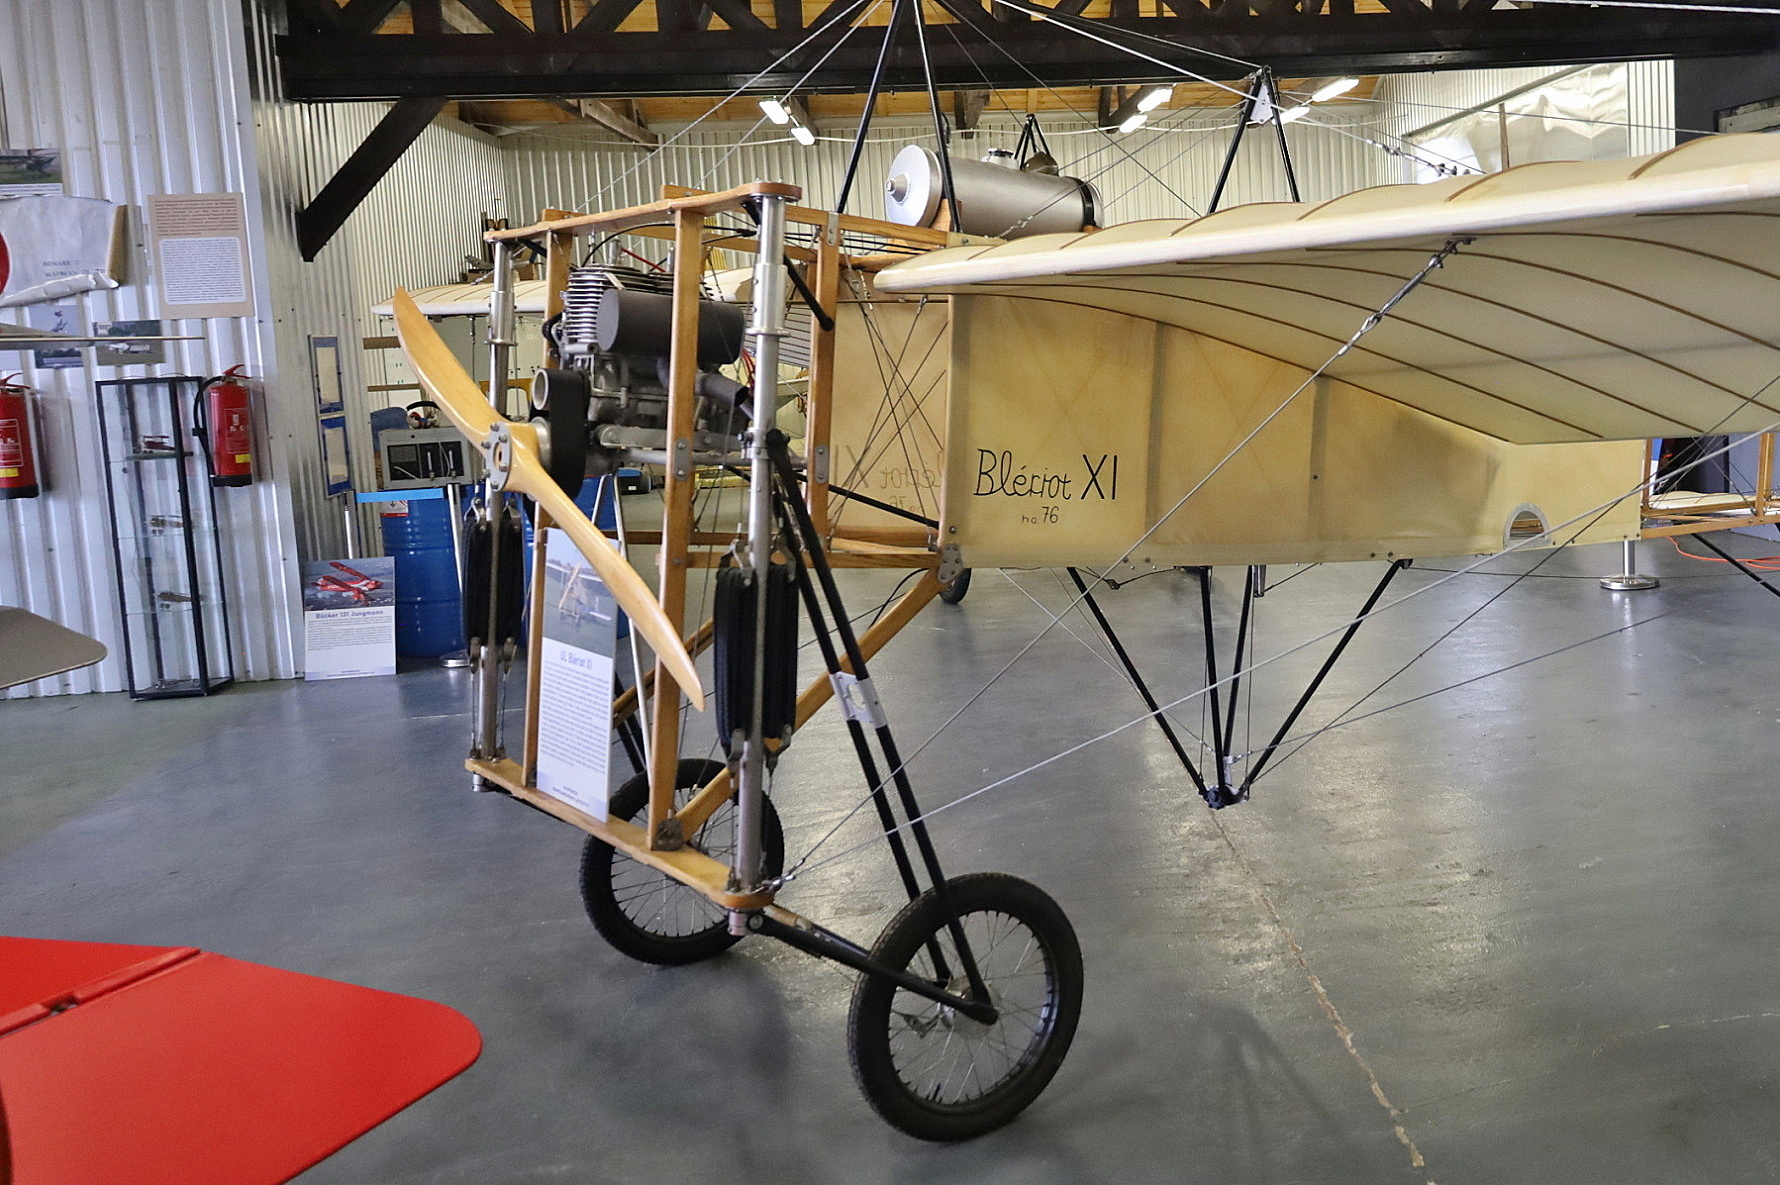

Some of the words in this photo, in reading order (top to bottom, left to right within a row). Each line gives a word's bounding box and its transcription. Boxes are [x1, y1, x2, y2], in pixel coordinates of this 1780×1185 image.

[973, 448, 1071, 500] Blériot
[1081, 454, 1118, 500] XI
[1041, 505, 1060, 525] 76
[351, 610, 384, 618] Jungmann
